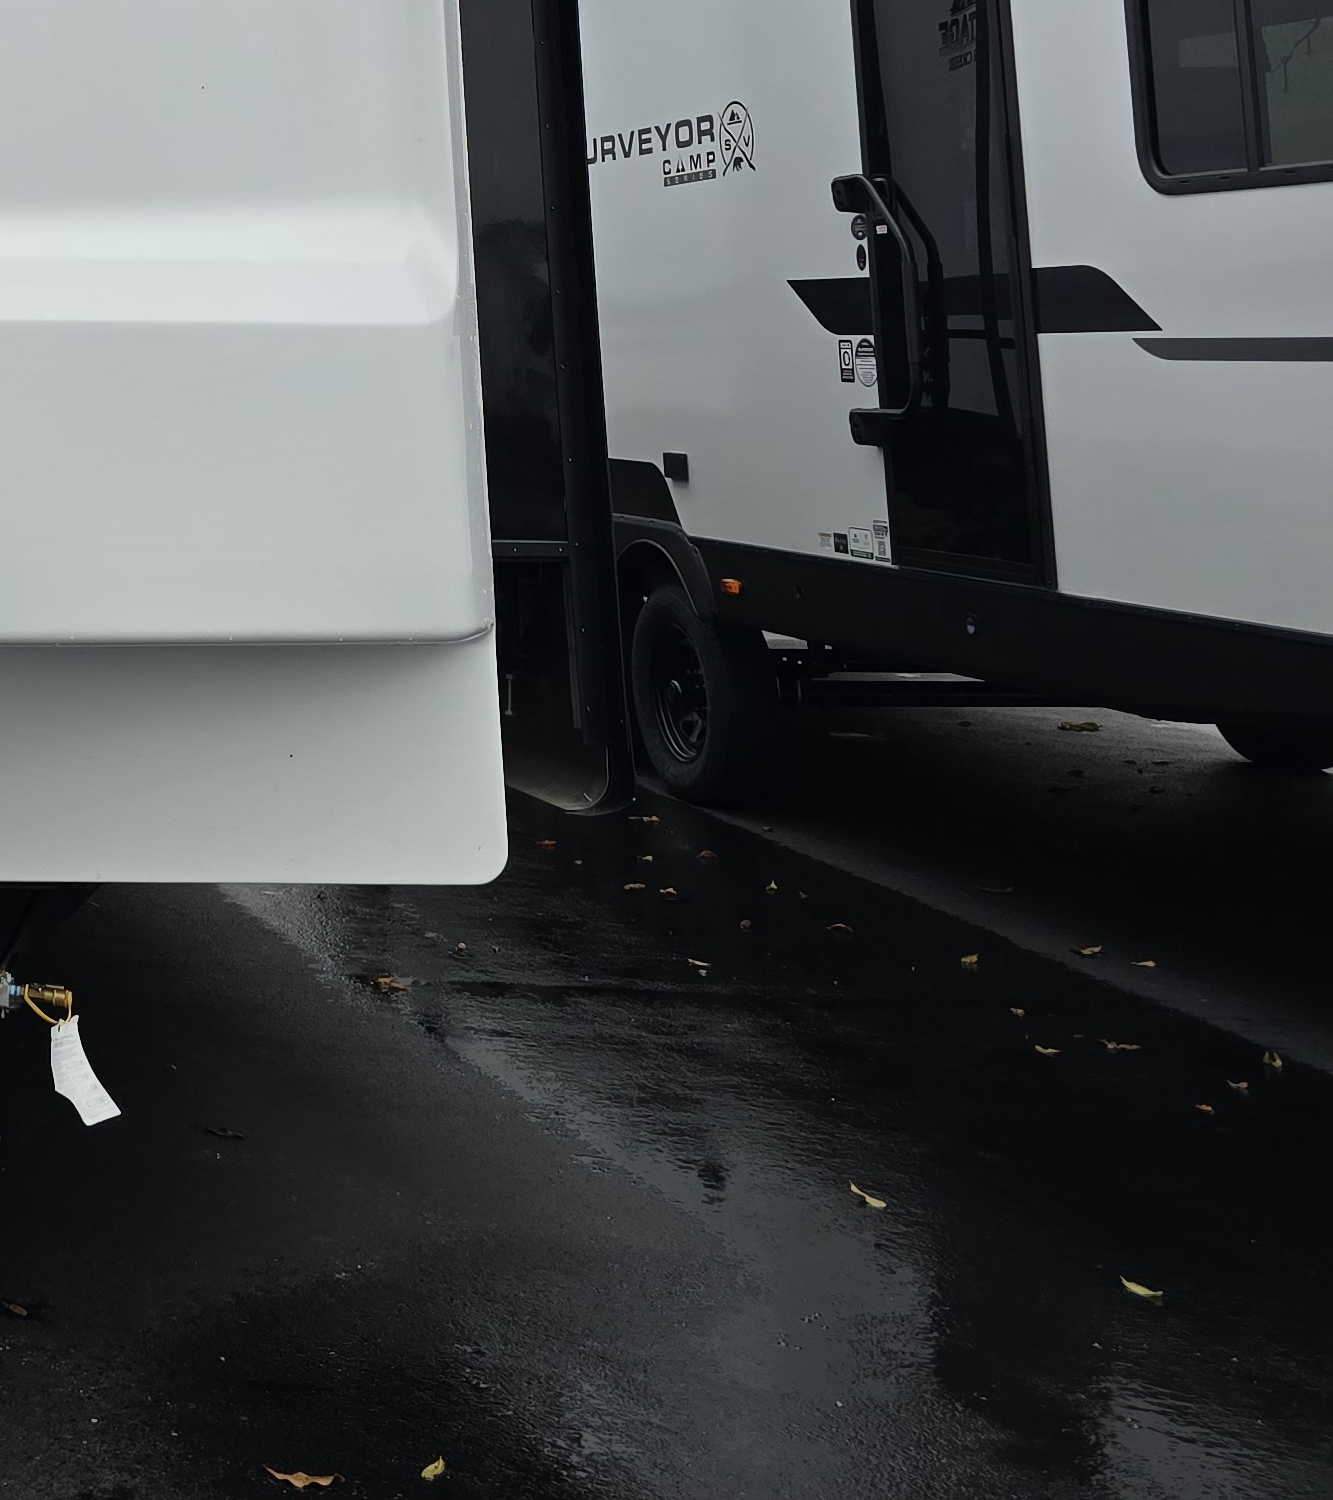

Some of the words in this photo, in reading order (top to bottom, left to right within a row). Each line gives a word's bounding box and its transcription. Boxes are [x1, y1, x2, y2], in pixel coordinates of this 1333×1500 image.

[586, 114, 716, 165] URVEYOR
[662, 151, 716, 176] CAMP
[665, 169, 715, 186] SERIES
